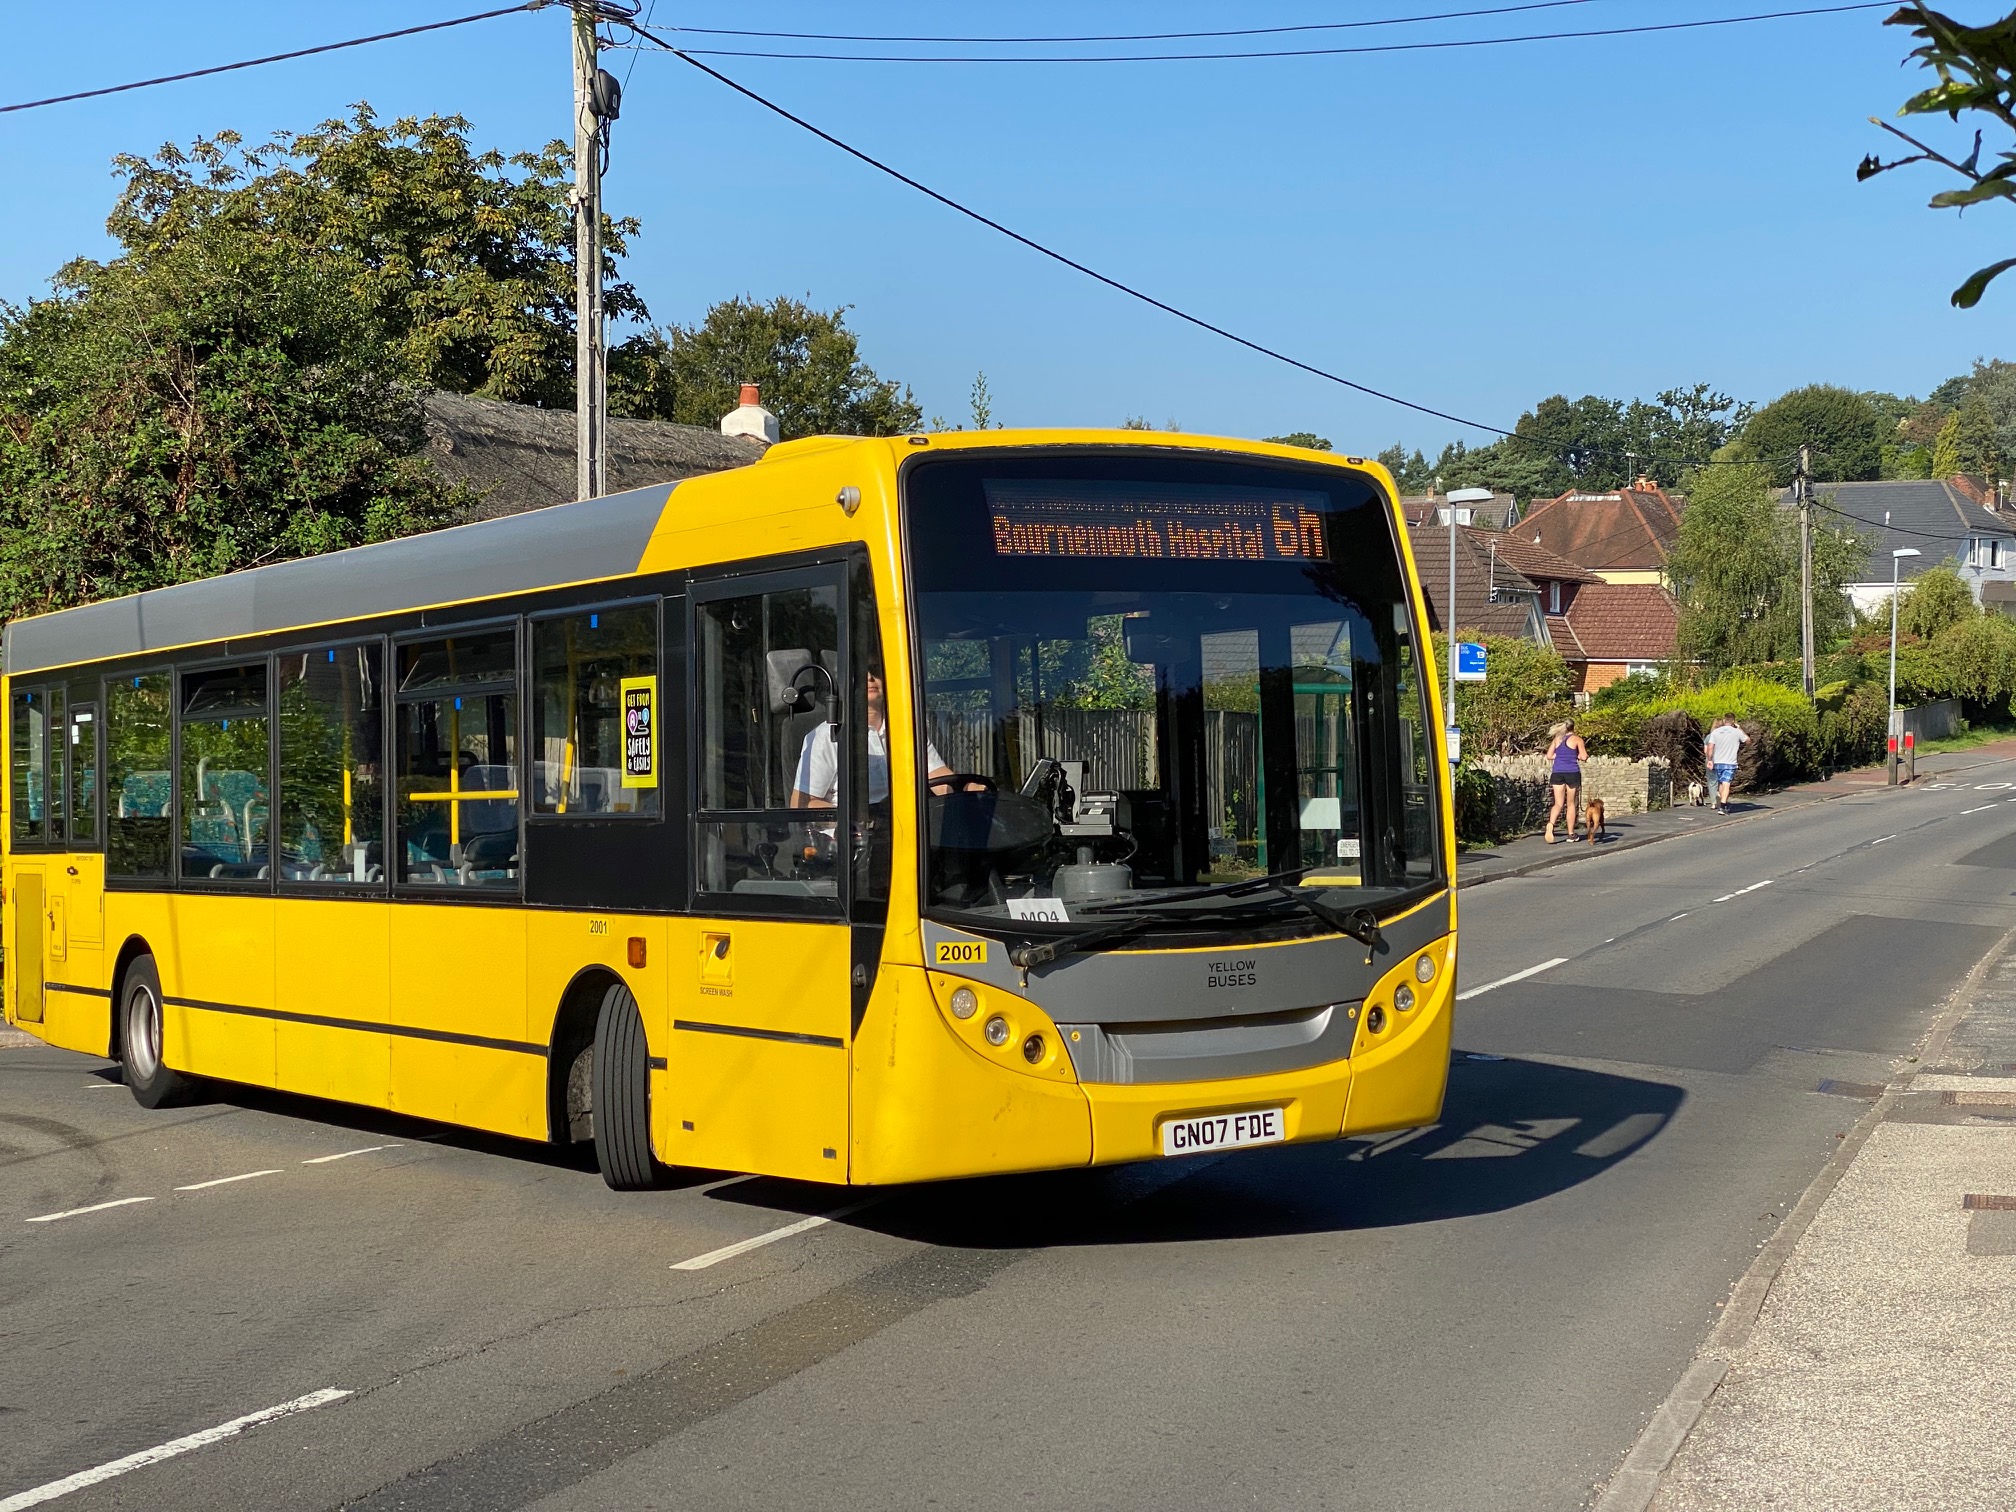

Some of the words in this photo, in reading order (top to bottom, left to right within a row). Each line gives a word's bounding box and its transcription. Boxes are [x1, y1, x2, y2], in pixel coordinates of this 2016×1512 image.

[994, 516, 1162, 556] Bournemouth
[1167, 520, 1265, 559] Hospital
[1476, 651, 1485, 659] 13
[627, 694, 636, 707] GET
[636, 692, 650, 706] FROM
[628, 737, 650, 757] SAFELY
[633, 756, 651, 771] EASILY
[1920, 783, 2016, 791] SLO
[590, 920, 607, 934] 2001
[940, 945, 981, 961] 2001
[1208, 960, 1256, 972] YELLOW
[1208, 973, 1256, 988] BUSES
[700, 986, 719, 996] SCREEN
[719, 988, 732, 997] WASH
[1173, 1119, 1228, 1149] GN07
[1235, 1112, 1276, 1141] FDE
